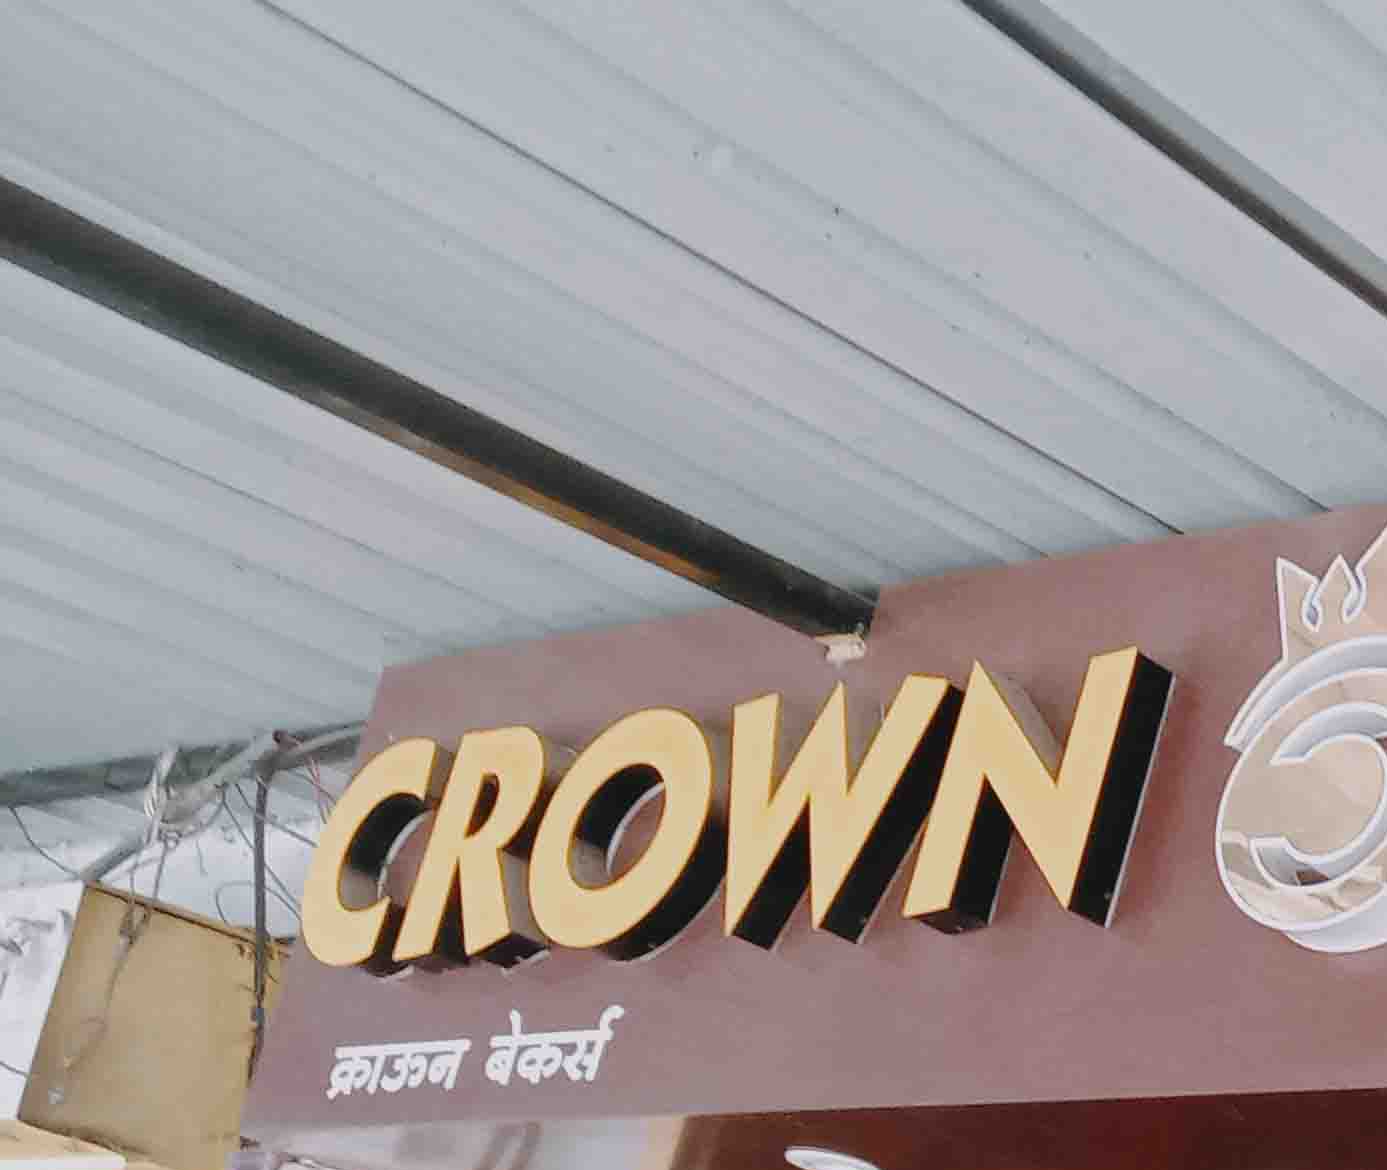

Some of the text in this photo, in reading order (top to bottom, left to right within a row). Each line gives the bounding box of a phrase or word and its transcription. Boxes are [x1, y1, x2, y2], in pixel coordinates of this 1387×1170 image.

[301, 646, 1172, 976] CROWN
[325, 1004, 626, 1100] क्राऊन बेकर्स
